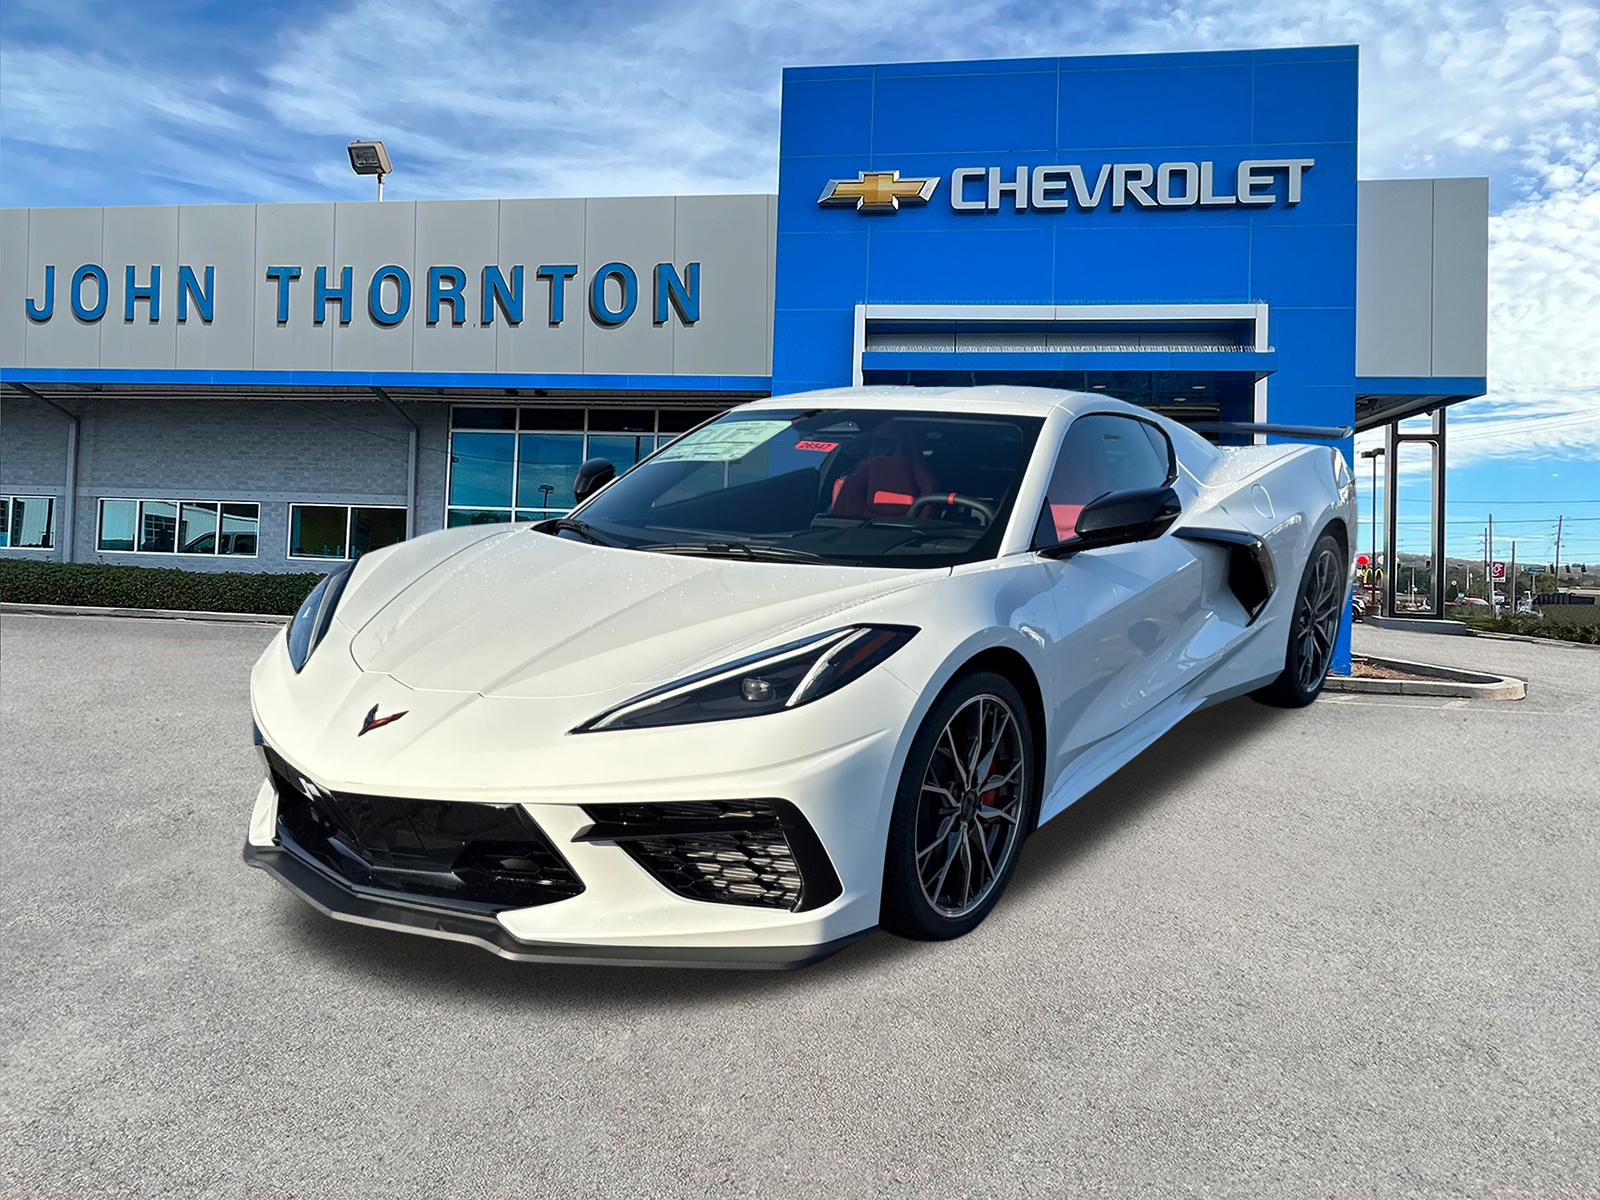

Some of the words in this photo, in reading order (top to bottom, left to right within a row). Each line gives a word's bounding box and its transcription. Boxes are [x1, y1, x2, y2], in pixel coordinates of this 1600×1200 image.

[950, 158, 1316, 213] CHEVROLET
[25, 264, 215, 324] JOHN
[266, 262, 701, 328] THORNTON
